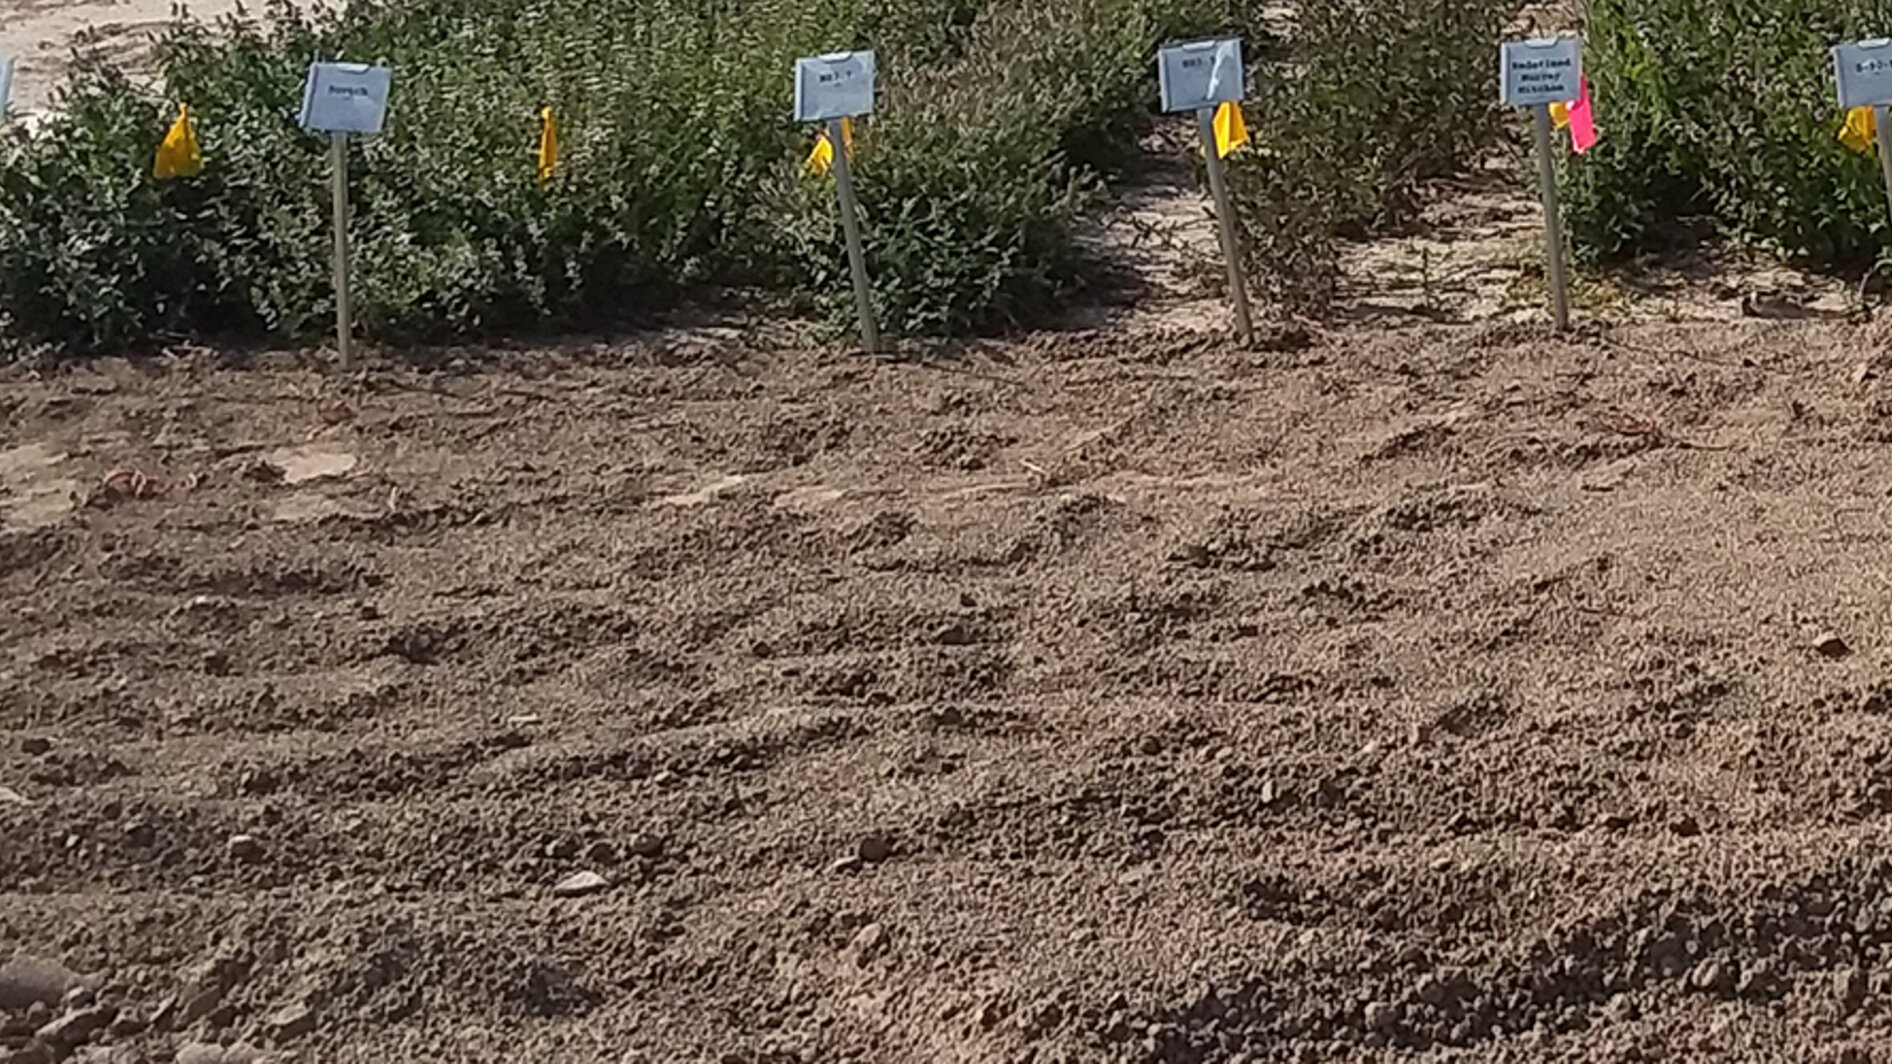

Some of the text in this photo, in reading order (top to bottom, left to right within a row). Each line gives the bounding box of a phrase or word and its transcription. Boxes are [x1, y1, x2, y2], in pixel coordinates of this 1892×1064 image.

[1512, 58, 1571, 70] Redefined
[1521, 73, 1560, 81] Murray
[1518, 84, 1564, 93] Mitcham
